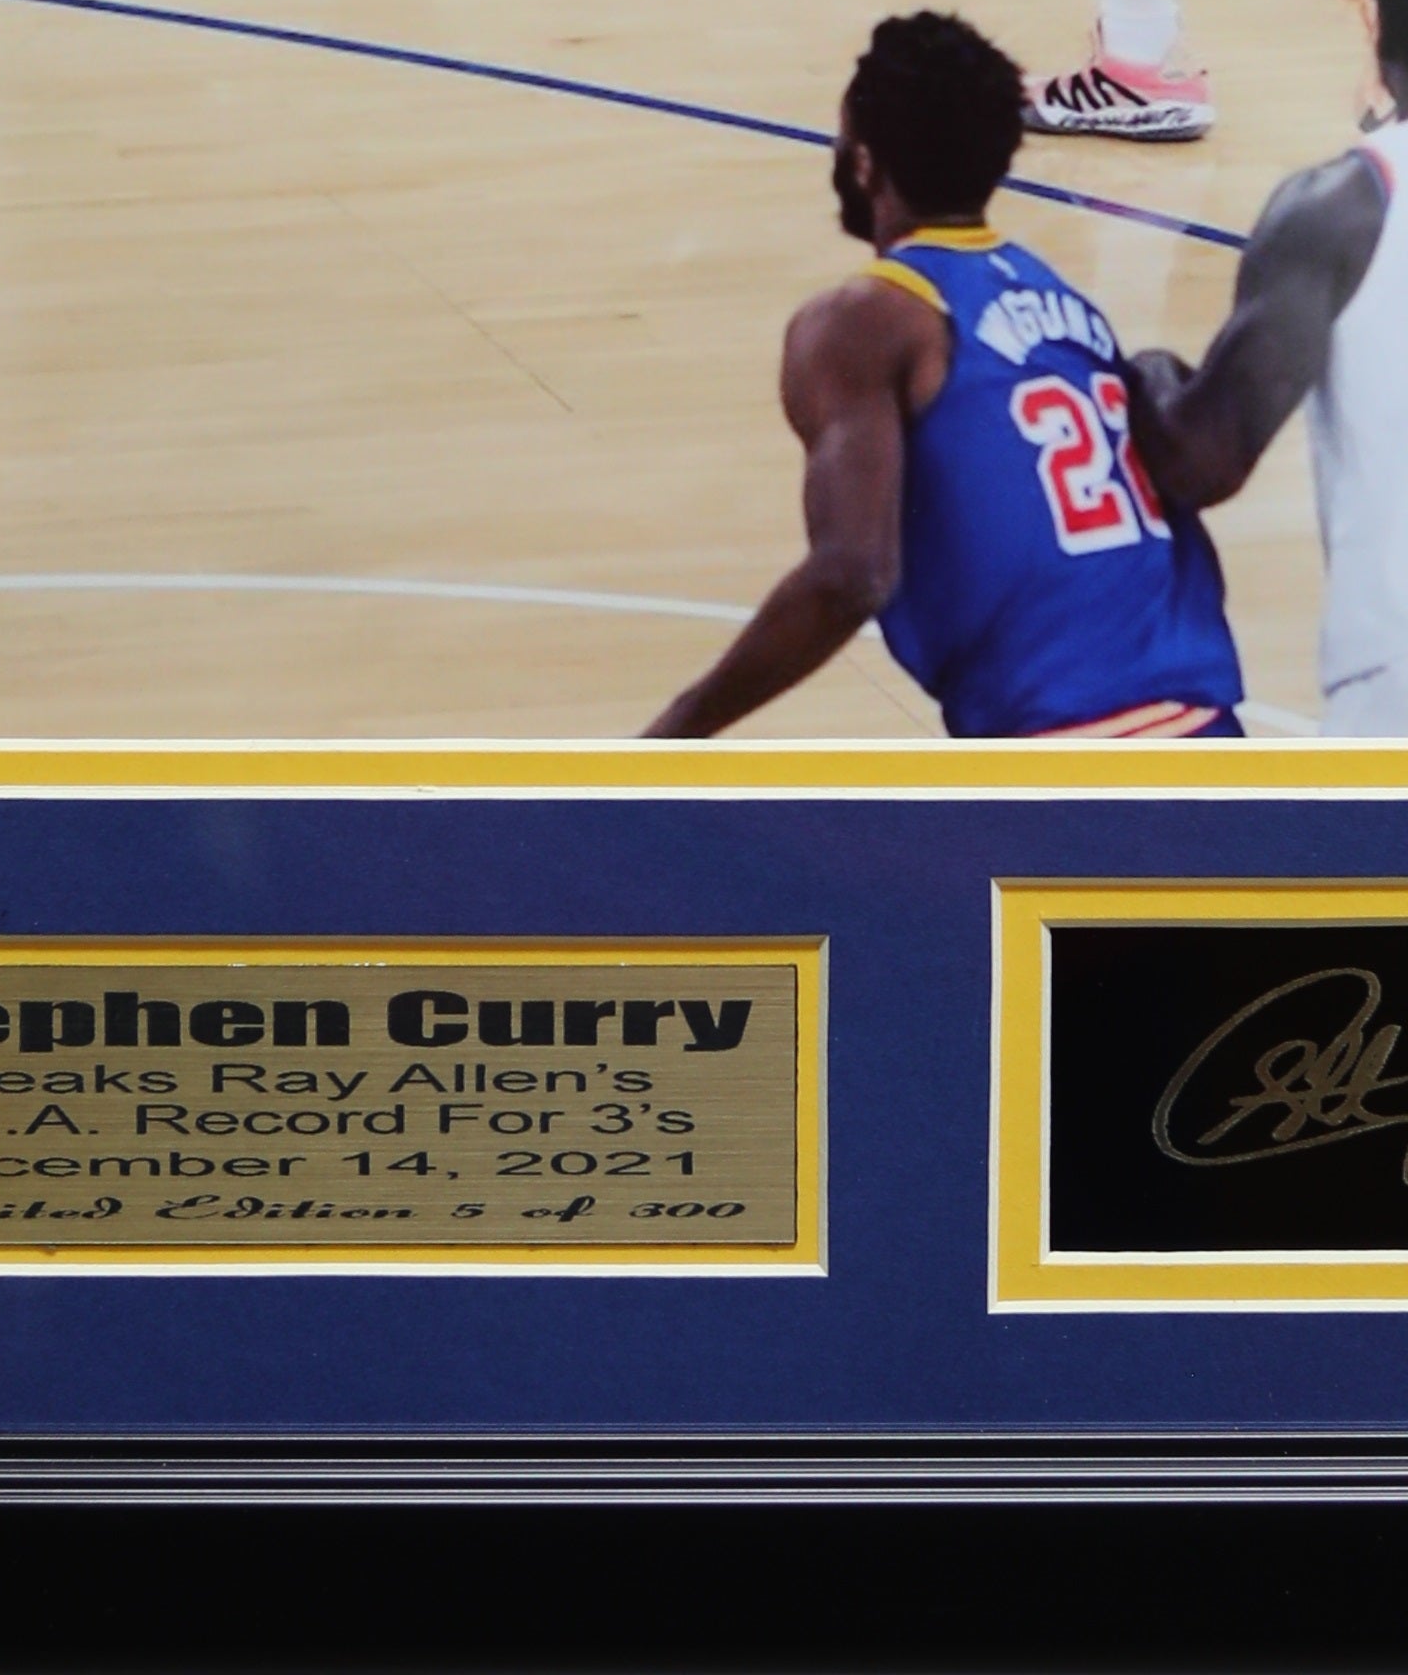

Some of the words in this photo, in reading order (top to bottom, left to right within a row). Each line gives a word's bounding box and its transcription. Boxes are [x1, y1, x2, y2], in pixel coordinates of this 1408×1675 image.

[386, 989, 753, 1052] Curry
[211, 1063, 370, 1104] Ray
[389, 1062, 654, 1095] Allen's
[135, 1103, 405, 1136] Record
[439, 1103, 564, 1135] For
[590, 1102, 695, 1135] 3's
[341, 1151, 459, 1181] 14,
[495, 1150, 694, 1177] 2021
[154, 1194, 417, 1221] Edition
[450, 1202, 486, 1220] 5
[520, 1195, 596, 1223] of
[629, 1201, 746, 1220] 300
